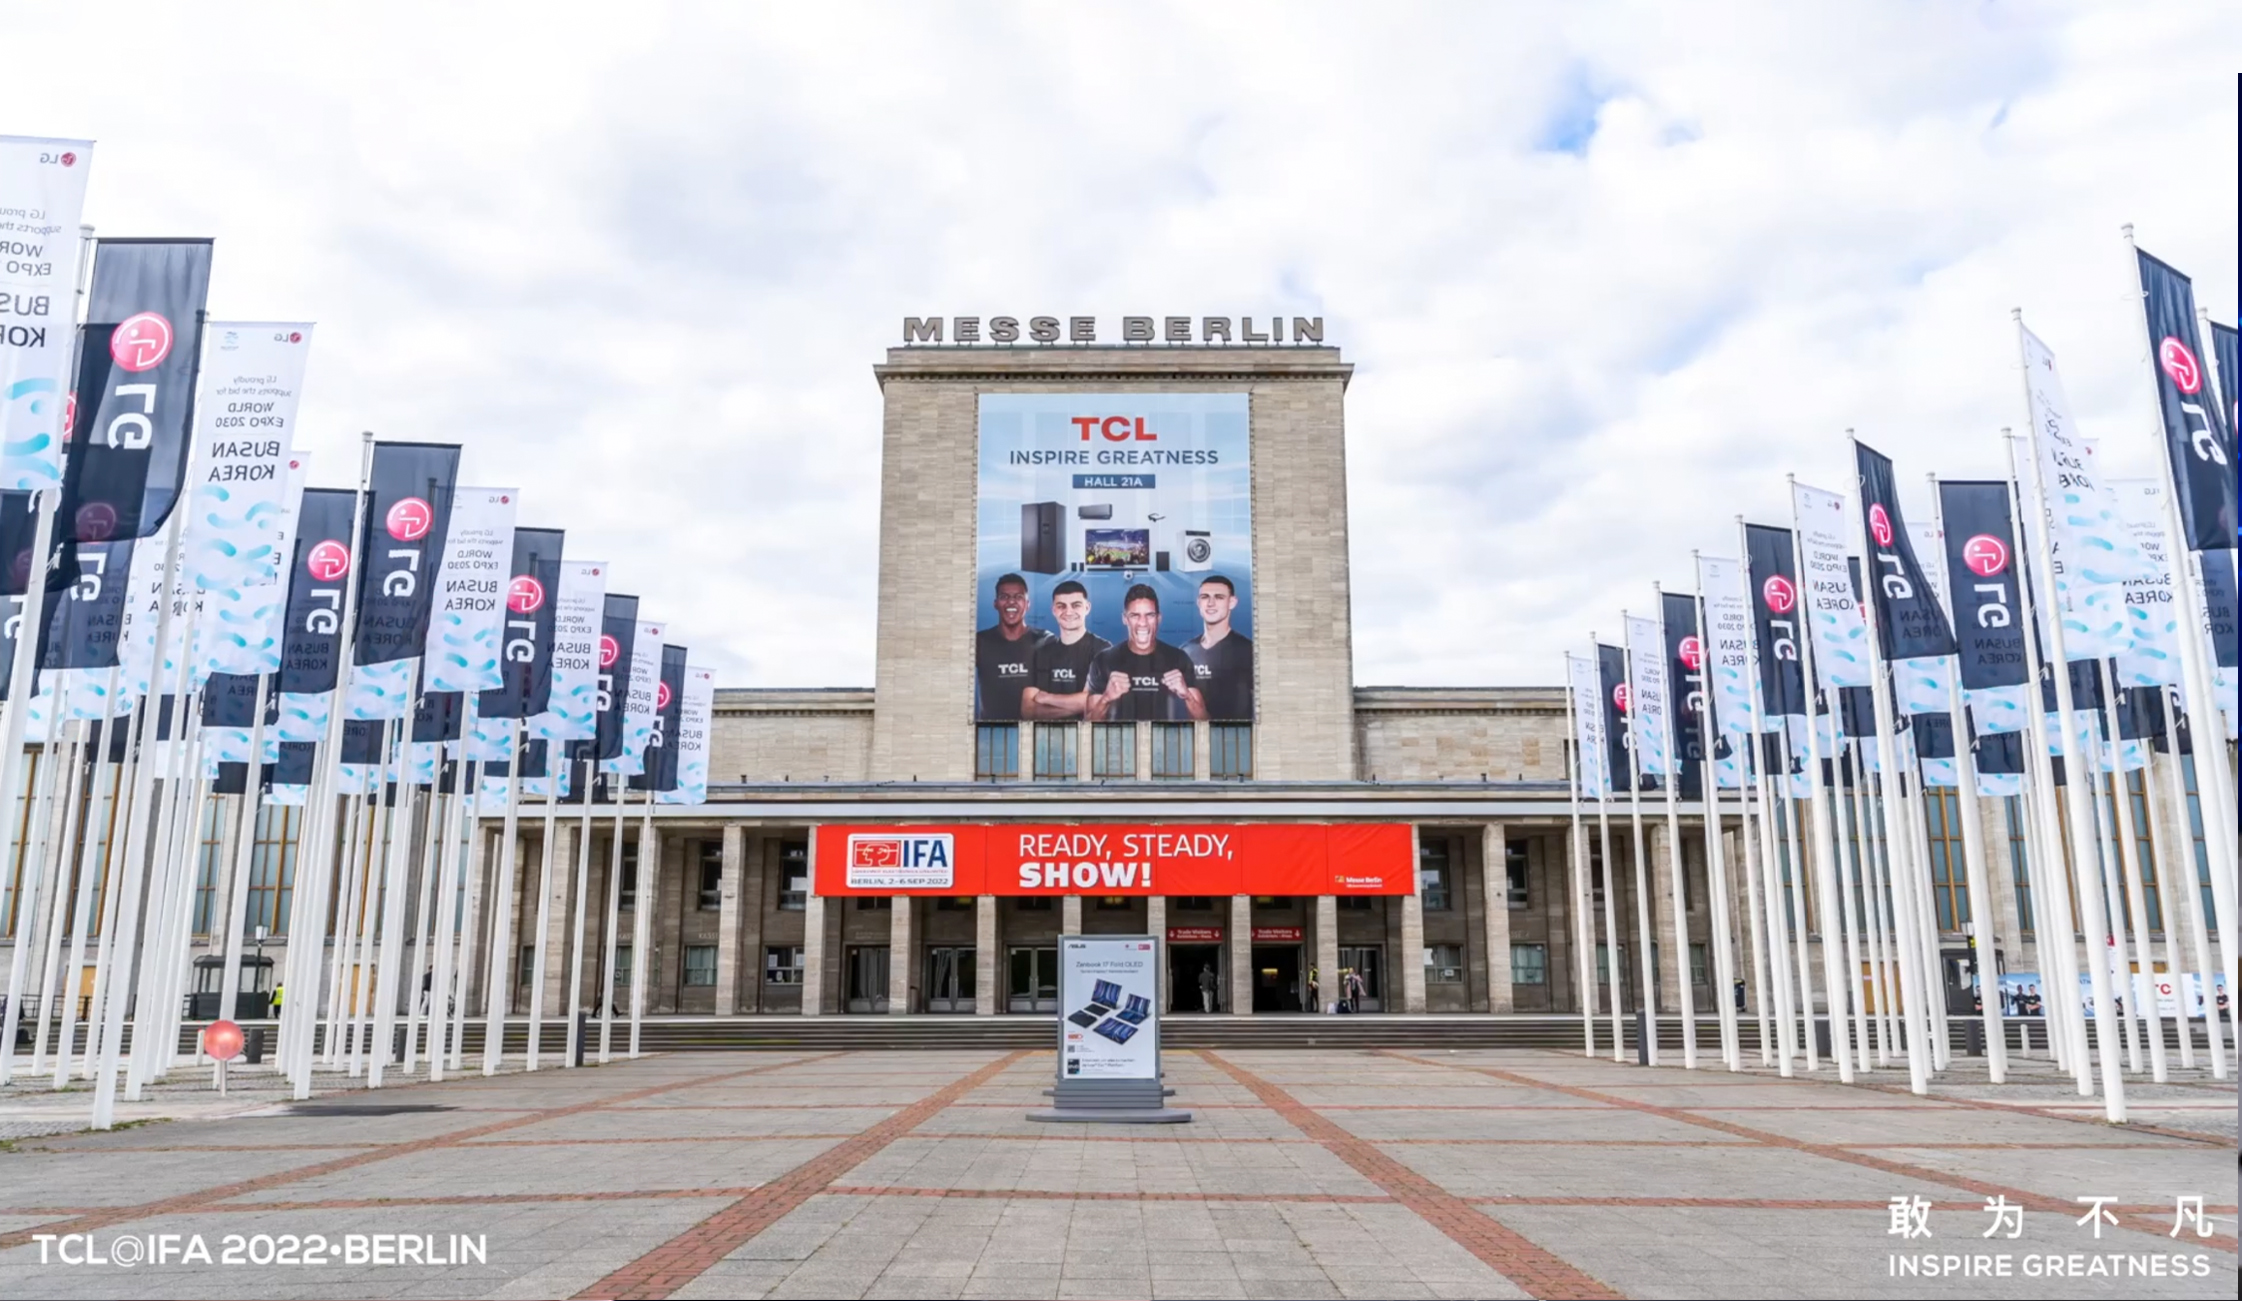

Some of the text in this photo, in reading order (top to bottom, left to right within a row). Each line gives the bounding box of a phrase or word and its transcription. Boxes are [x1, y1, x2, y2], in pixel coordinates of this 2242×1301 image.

[903, 316, 1324, 342] MESSE BERLIN
[1071, 416, 1157, 442] TCL
[1010, 450, 1219, 465] INSPIRE GREATNESS
[1084, 477, 1143, 487] HALL 21A
[998, 663, 1028, 675] TCL
[1052, 668, 1076, 679] TCL
[1132, 677, 1159, 686] TCL
[903, 840, 948, 867] IFA
[1019, 833, 1233, 860] READY, STEADY,
[851, 878, 887, 886] BERLIN,
[1019, 861, 1151, 888] SHOW!
